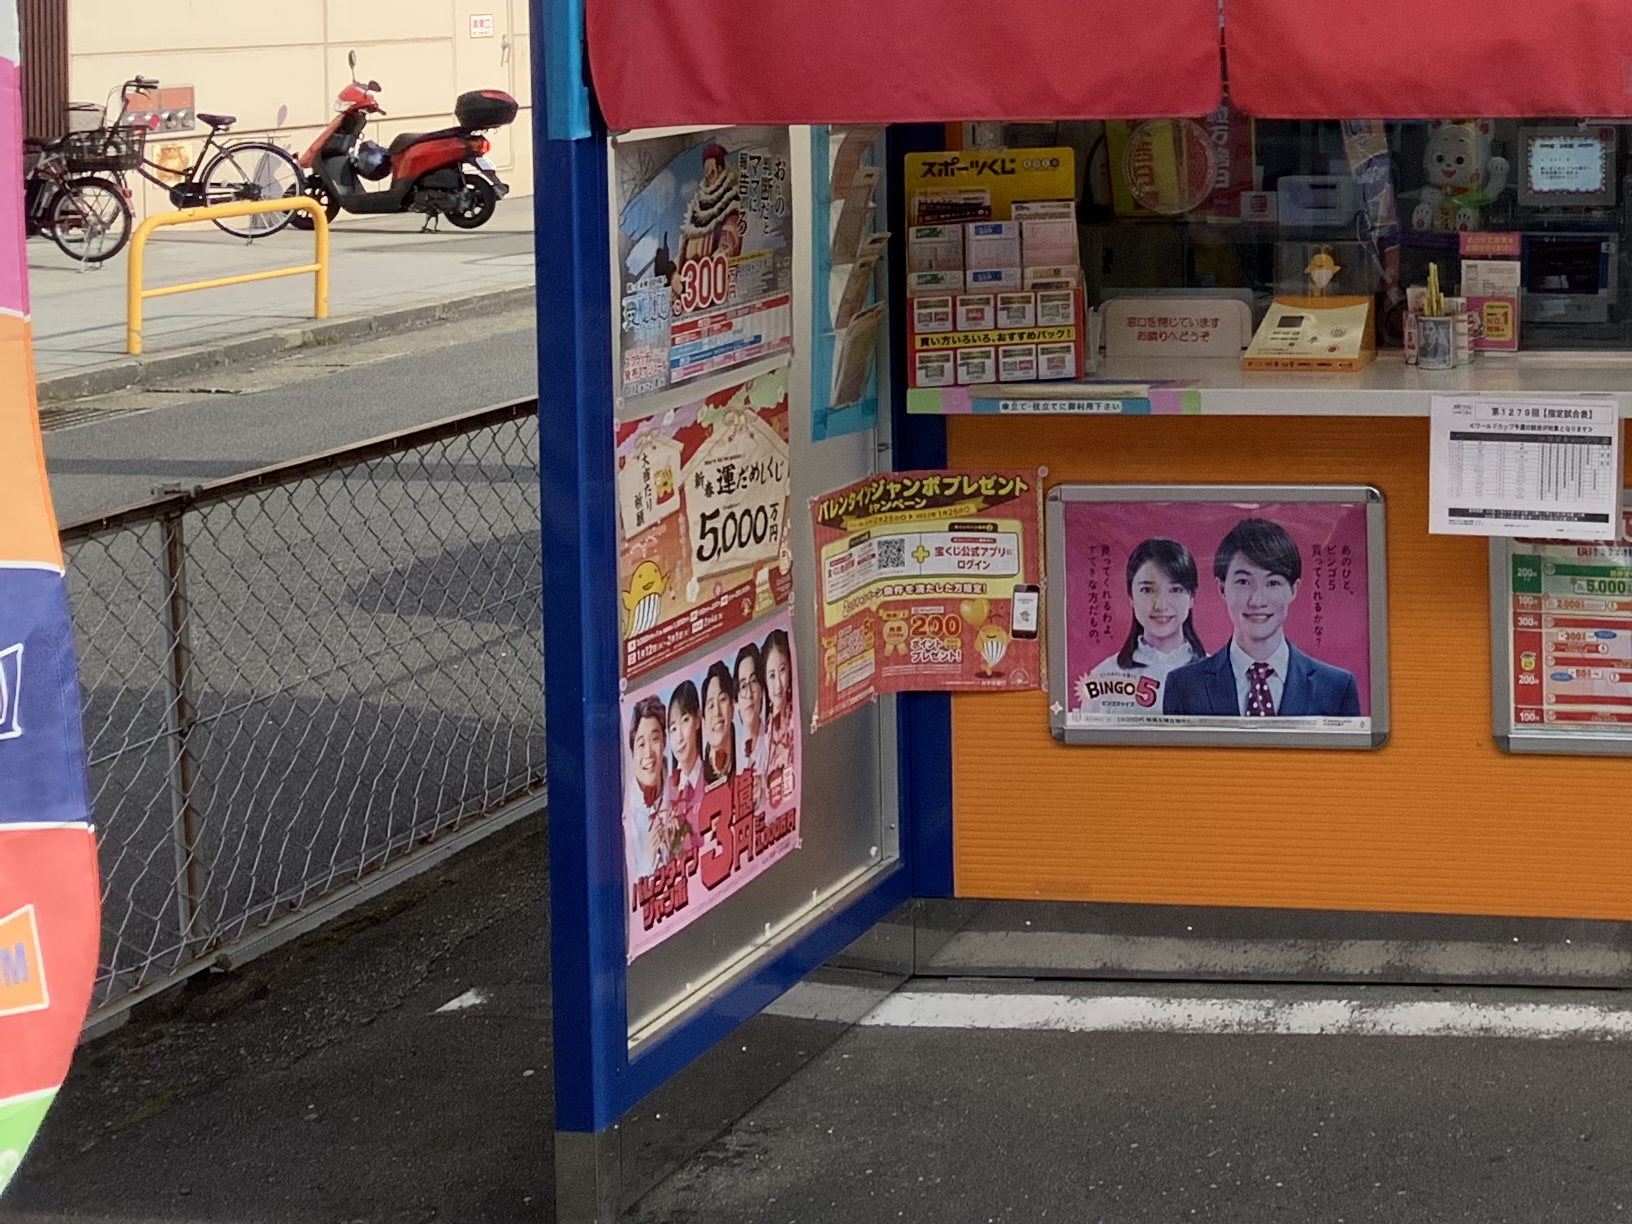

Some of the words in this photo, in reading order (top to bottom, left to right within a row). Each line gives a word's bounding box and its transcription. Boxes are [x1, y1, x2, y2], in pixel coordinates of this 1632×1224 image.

[920, 156, 1017, 179] スポーツくじ
[957, 559, 992, 571] ログイン
[910, 614, 963, 638] 200
